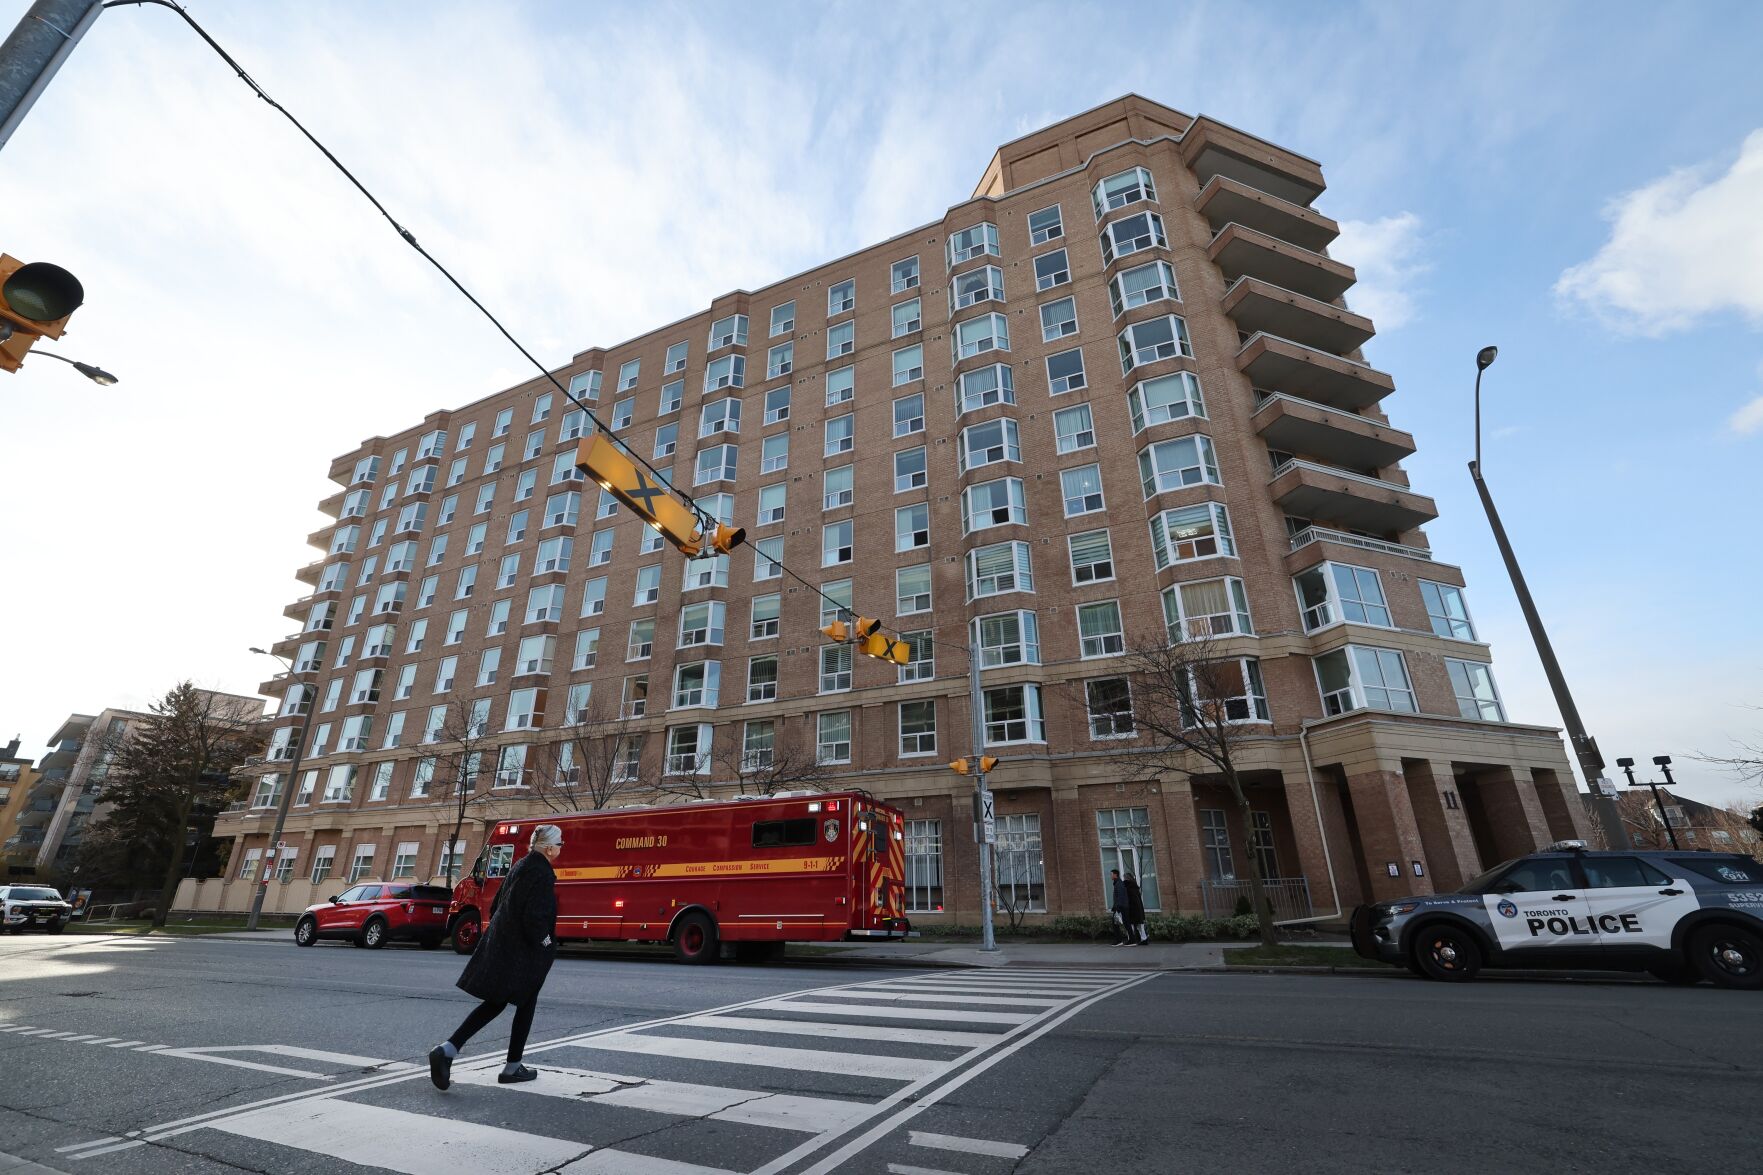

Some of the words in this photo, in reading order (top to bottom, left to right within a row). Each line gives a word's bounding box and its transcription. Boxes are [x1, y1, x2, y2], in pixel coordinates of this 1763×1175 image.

[615, 836, 655, 850] COMMAND
[656, 835, 668, 848] 30
[803, 860, 818, 870] 9-1-1
[1523, 909, 1569, 917] TORONTO
[1526, 913, 1643, 937] POLICE
